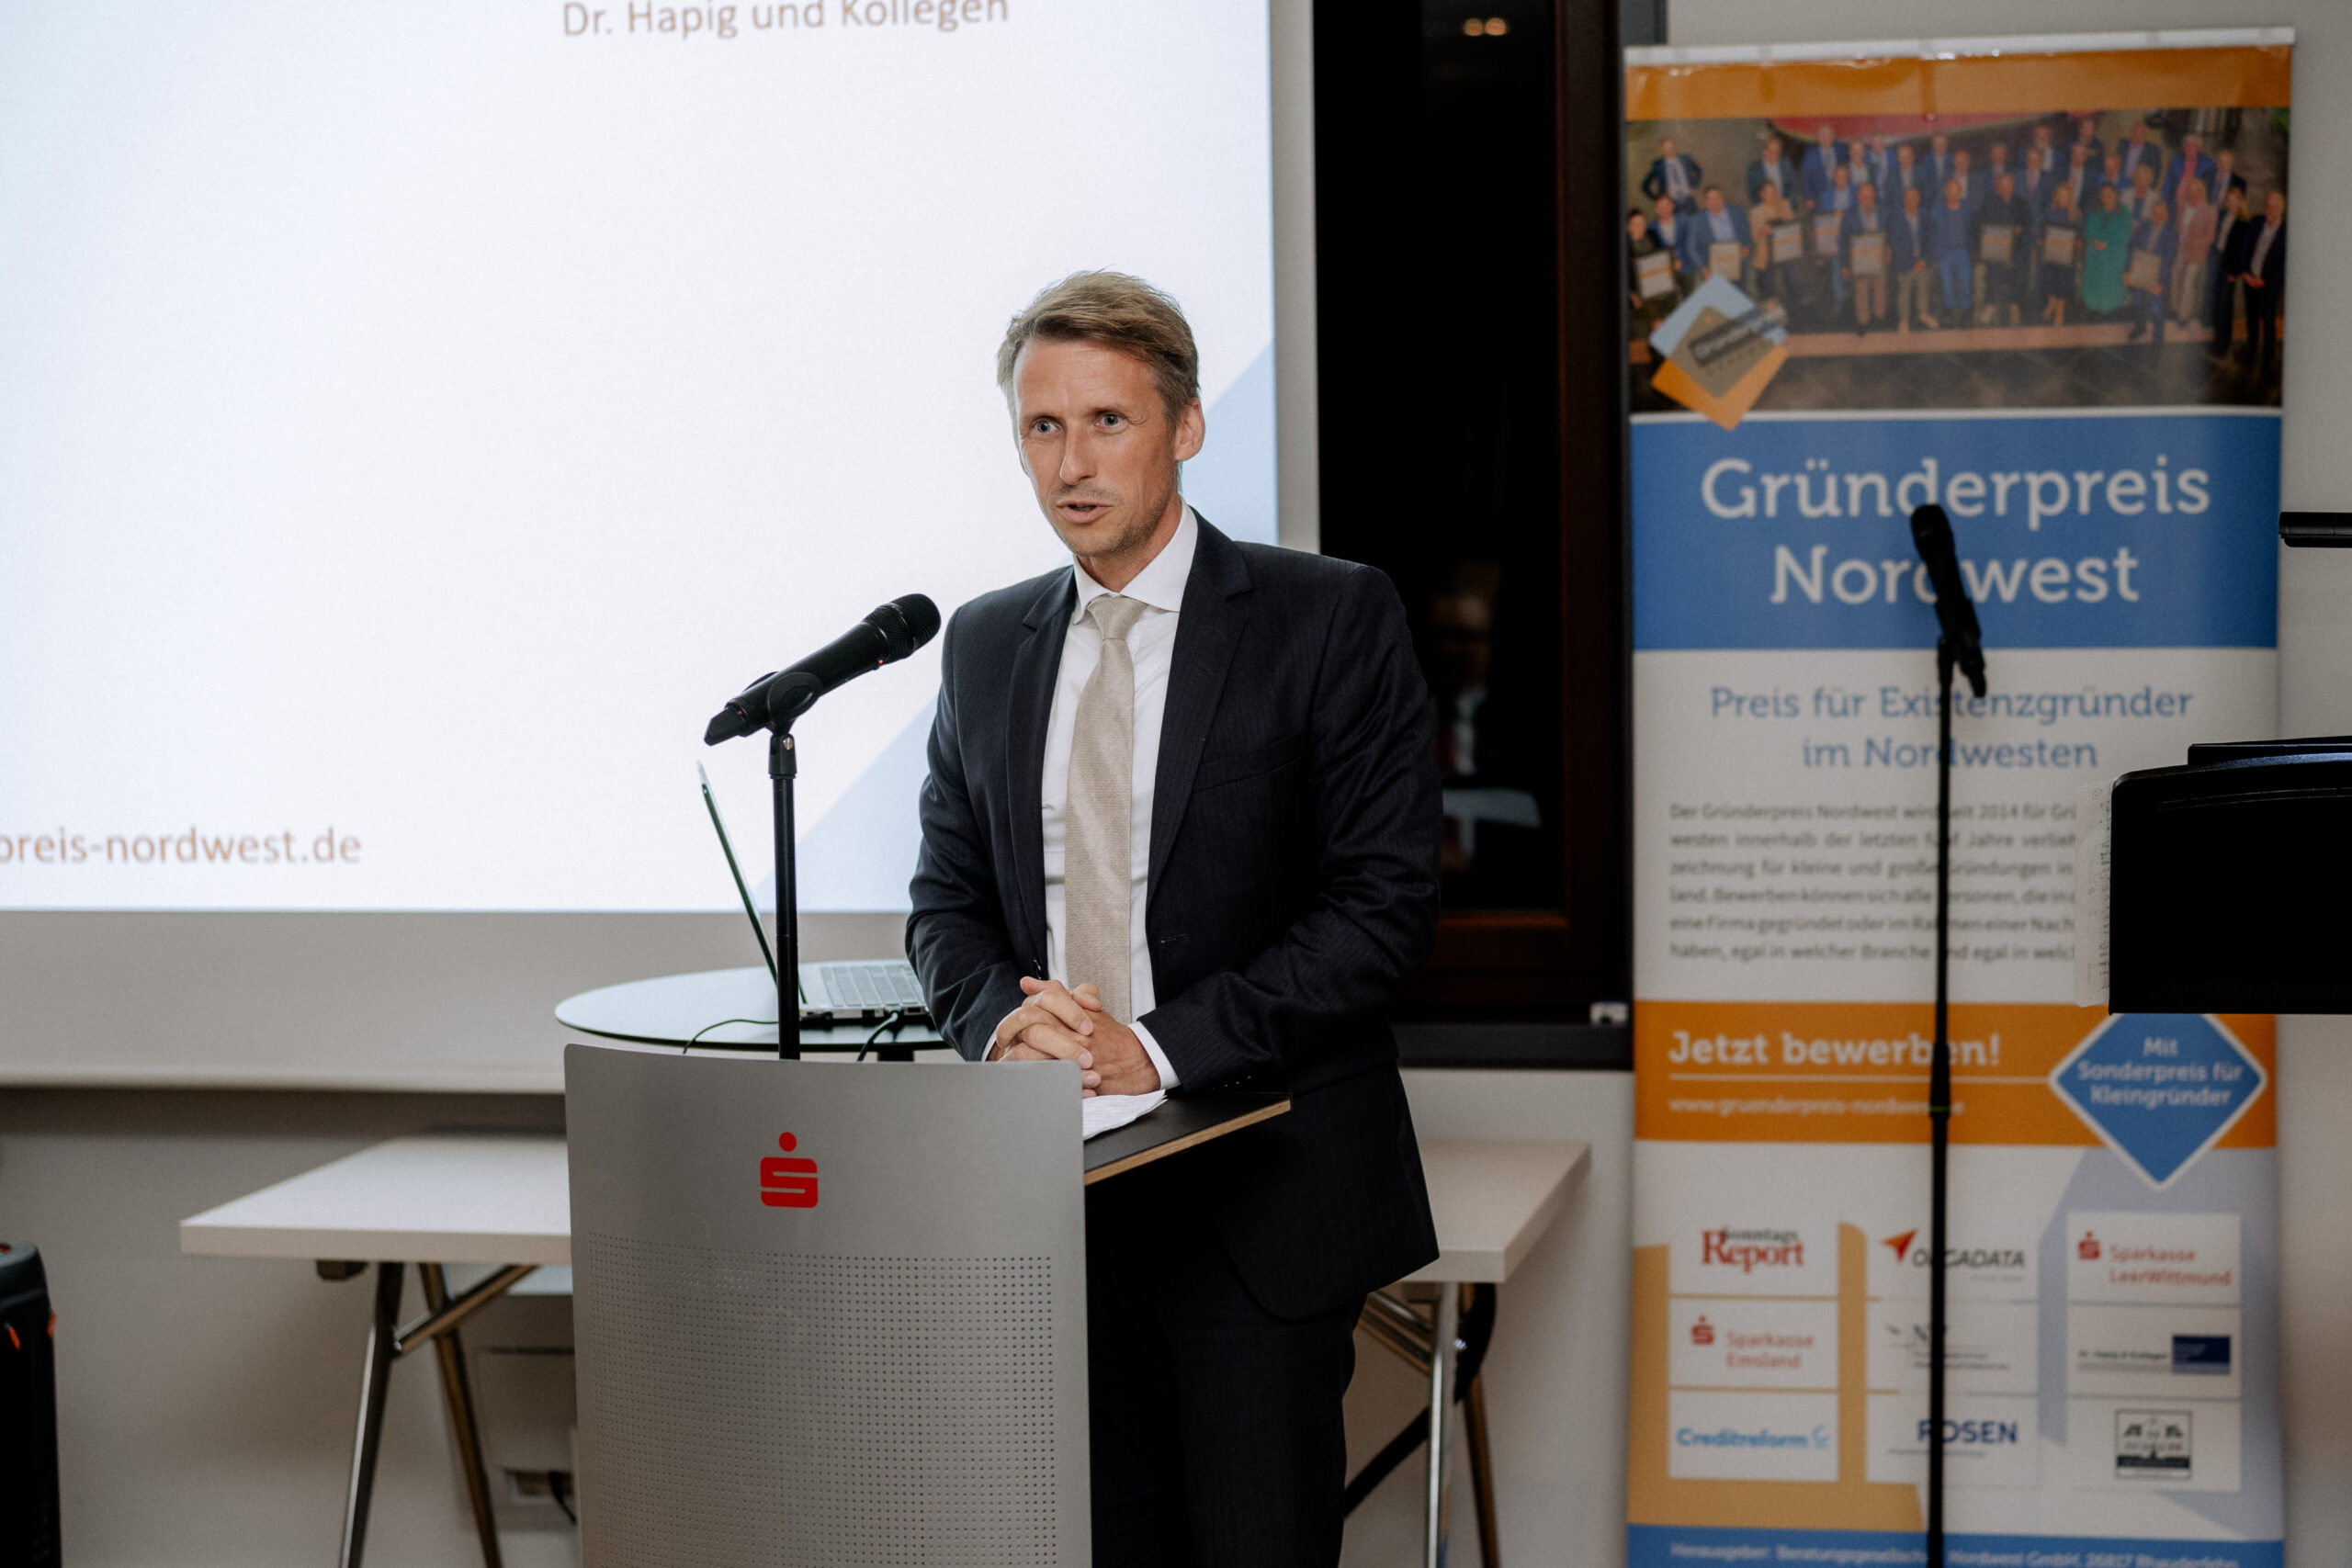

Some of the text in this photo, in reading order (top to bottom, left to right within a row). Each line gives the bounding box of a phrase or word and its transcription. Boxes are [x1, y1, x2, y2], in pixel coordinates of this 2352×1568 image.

[563, 0, 1010, 39] Dr. Hapig und Kollegen
[1701, 455, 2210, 531] Gründerpreis
[1710, 687, 1800, 717] Preis
[1813, 686, 1866, 717] für
[1802, 739, 1850, 768] im
[1668, 1030, 1770, 1065] Jetzt
[2143, 1035, 2179, 1056] Mit
[2077, 1058, 2244, 1084] Sonderpreis für
[2089, 1083, 2232, 1111] Kleingründer
[1702, 1228, 1804, 1274] Report
[2110, 1246, 2197, 1263] Sparkasse
[1726, 1330, 1815, 1349] Sparkasse
[1726, 1350, 1803, 1370] Emsland
[1676, 1427, 1809, 1449] Creditreform
